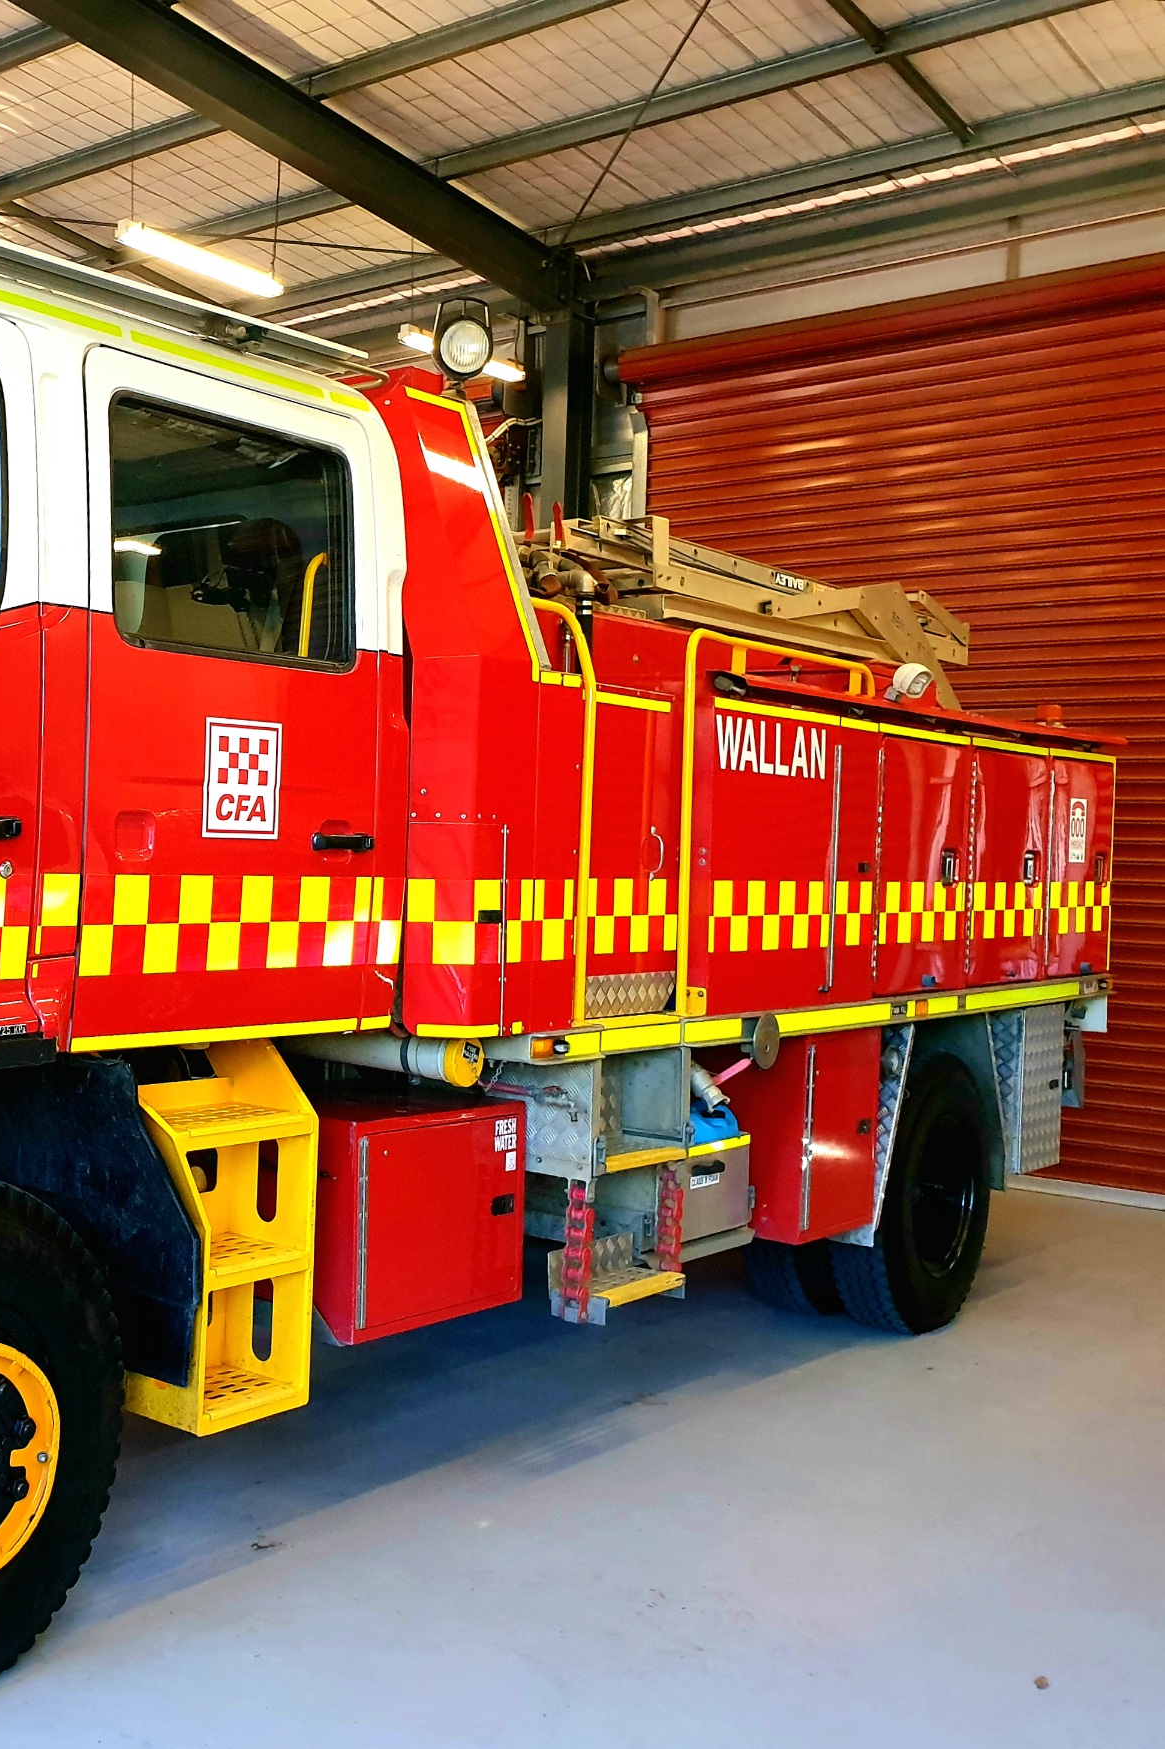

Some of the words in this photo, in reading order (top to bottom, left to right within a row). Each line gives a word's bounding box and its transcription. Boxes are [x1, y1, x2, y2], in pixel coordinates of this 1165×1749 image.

[775, 572, 804, 591] BAILEY
[716, 714, 827, 780] WALLAN
[215, 793, 267, 822] CFA
[1070, 817, 1085, 838] 000
[495, 1118, 517, 1135] FRESH
[494, 1134, 517, 1152] WATER
